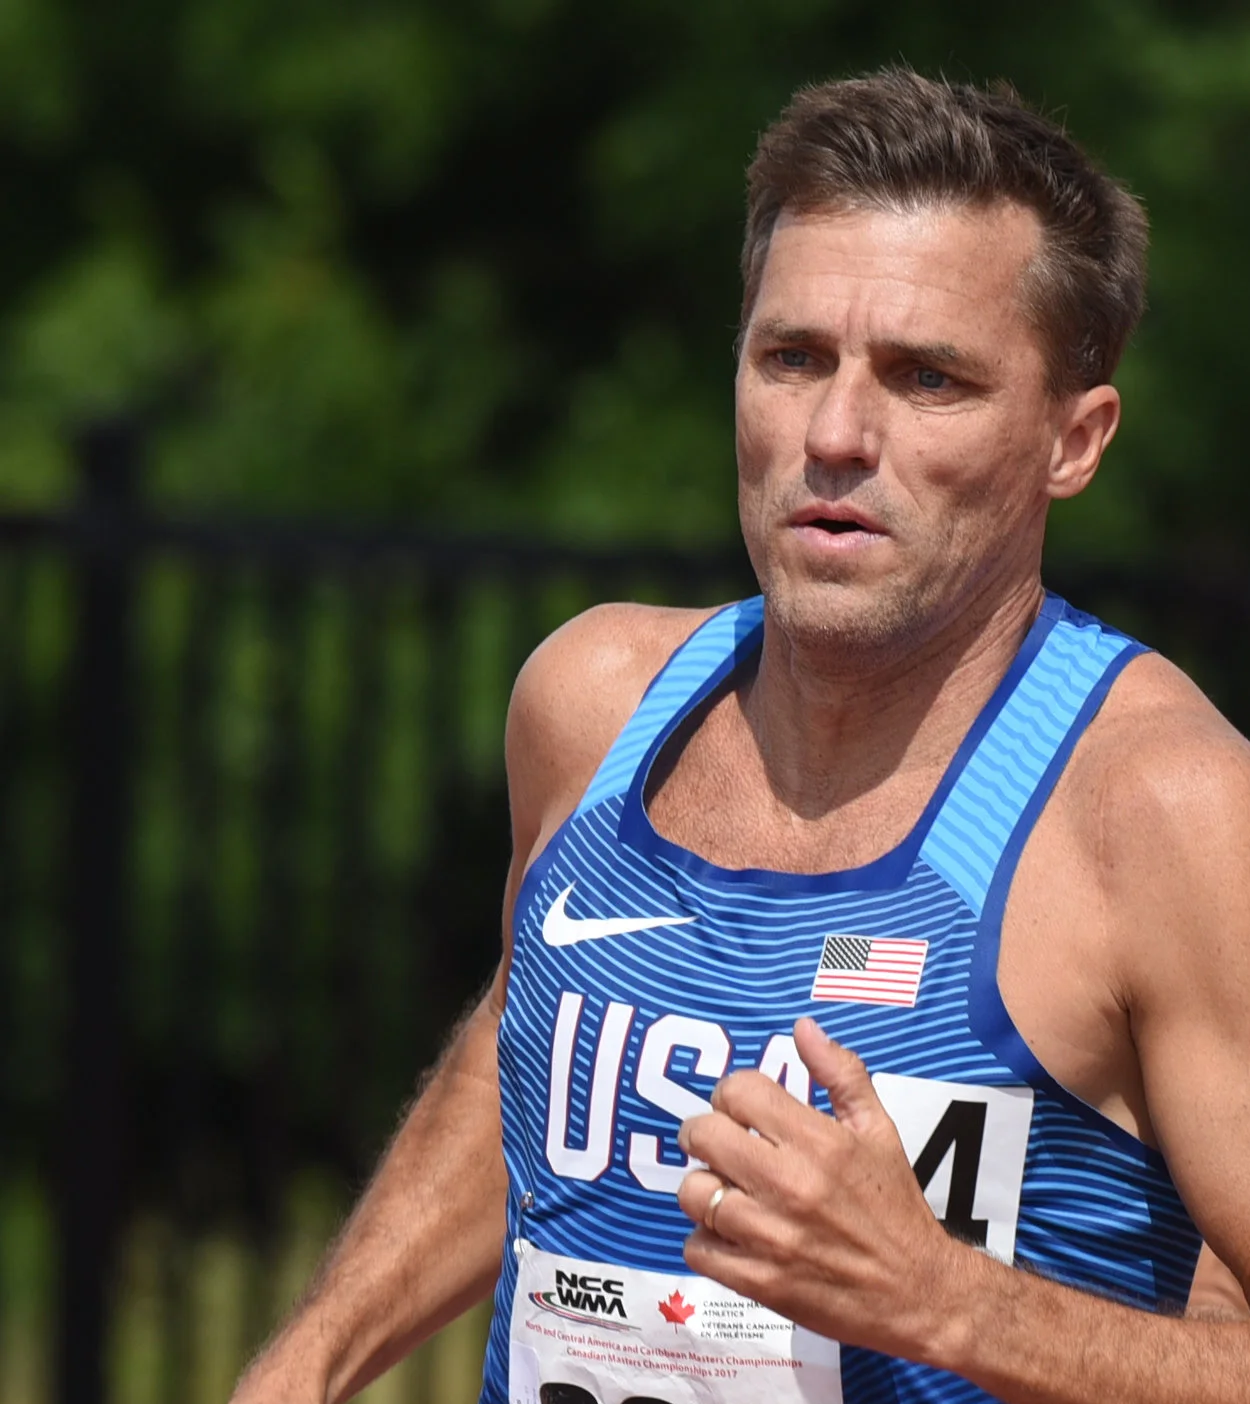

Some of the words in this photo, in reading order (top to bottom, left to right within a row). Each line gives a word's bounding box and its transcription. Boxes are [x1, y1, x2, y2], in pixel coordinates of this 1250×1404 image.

[912, 1099, 990, 1246] 4
[555, 1269, 624, 1296] NCC
[556, 1287, 628, 1319] WMA
[702, 1309, 745, 1318] ATHLETICS
[703, 1300, 745, 1309] CANADIAN
[525, 1319, 543, 1333] North
[543, 1327, 556, 1339] and
[557, 1331, 586, 1345] Central
[587, 1337, 621, 1351] America
[622, 1342, 639, 1355] and
[640, 1347, 687, 1360] Caribbean
[688, 1351, 724, 1365] Masters
[725, 1356, 803, 1369] Championships
[566, 1346, 607, 1362] Canadian
[608, 1354, 642, 1369] Masters
[642, 1359, 713, 1378] Championships
[714, 1369, 738, 1379] 2017
